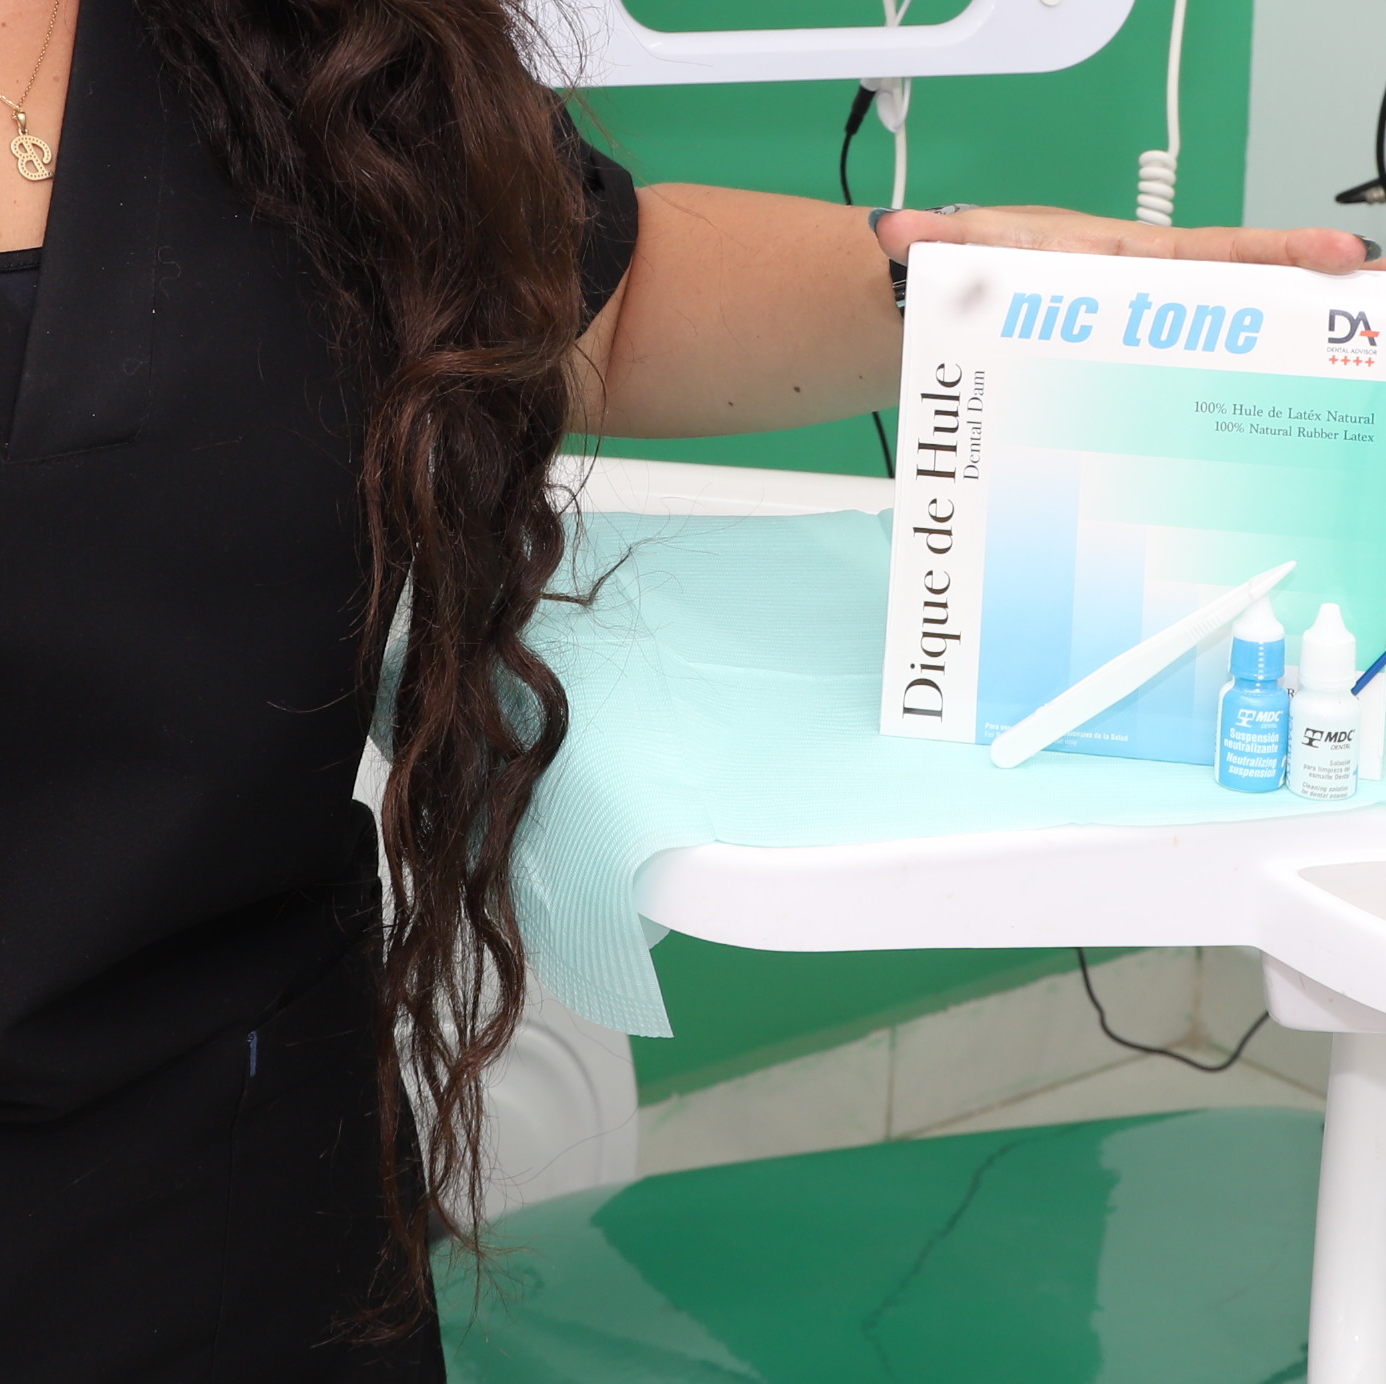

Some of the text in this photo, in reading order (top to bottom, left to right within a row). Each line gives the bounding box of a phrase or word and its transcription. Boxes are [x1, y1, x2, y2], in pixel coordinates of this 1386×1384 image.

[1000, 292, 1264, 354] nic tone
[1194, 400, 1375, 425] 100% Hule de Latéx Natural
[963, 370, 986, 480] Dental Dam
[1214, 421, 1375, 442] 100% Natural Rubber Latex
[902, 362, 963, 723] Dique de Hule
[1256, 710, 1284, 722] MDC
[1230, 728, 1280, 743] Suspensión
[1324, 729, 1356, 743] MDC
[1224, 738, 1278, 754] neutralizante
[1226, 751, 1278, 769] Neutralizing
[1229, 765, 1277, 778] suspension
